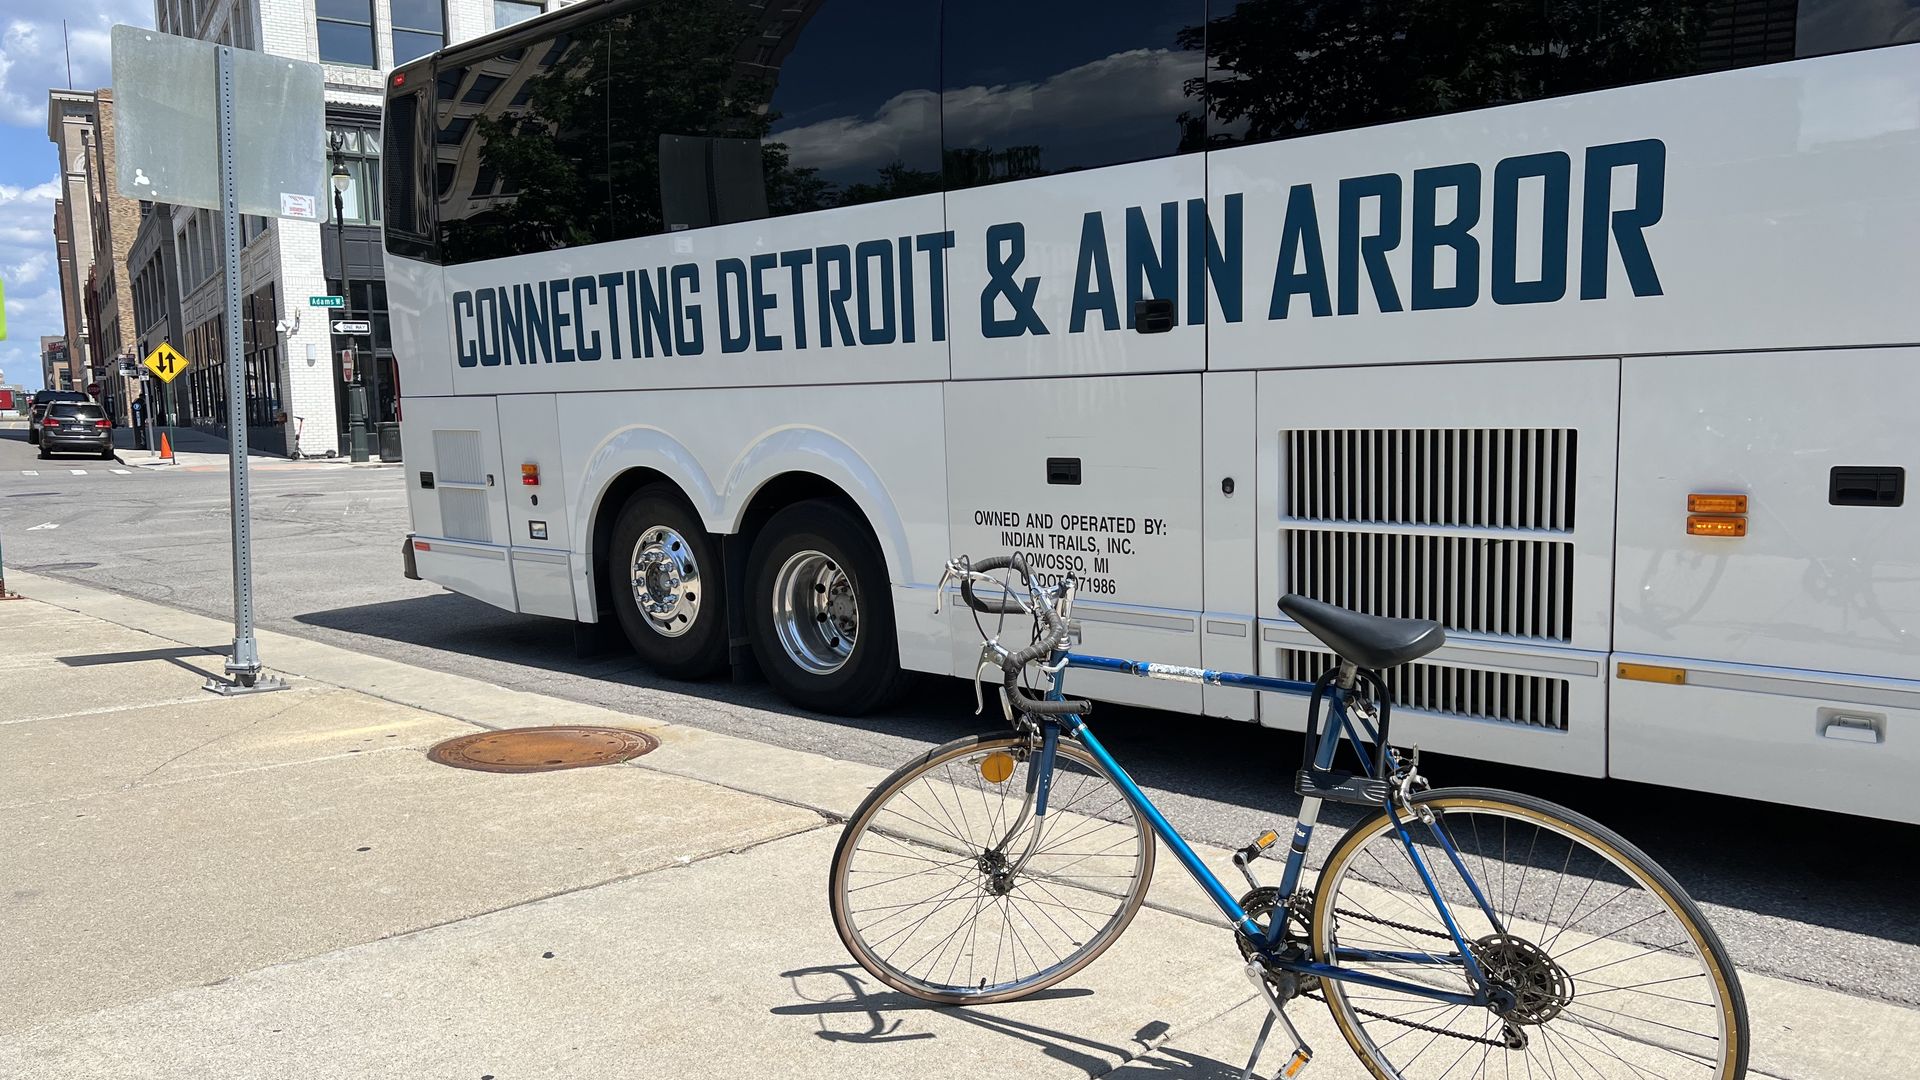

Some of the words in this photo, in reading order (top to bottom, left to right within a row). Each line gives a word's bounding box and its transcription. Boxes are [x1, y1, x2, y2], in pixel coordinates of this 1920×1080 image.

[453, 263, 704, 367] CONNECTING
[716, 230, 955, 353] DETROIT
[981, 222, 1050, 338] &
[1069, 193, 1243, 333] ANN
[1268, 138, 1665, 321] ARBOR
[974, 510, 1020, 527] OWNED
[1026, 513, 1053, 529] AND
[1060, 515, 1136, 534] OPERATED
[1144, 518, 1167, 535] BY:
[1001, 531, 1044, 549] INDIAN
[1049, 534, 1100, 555] TRAILS,
[1107, 537, 1136, 555] INC.
[1026, 552, 1087, 574] OWOSSO,
[1094, 557, 1109, 573] MI
